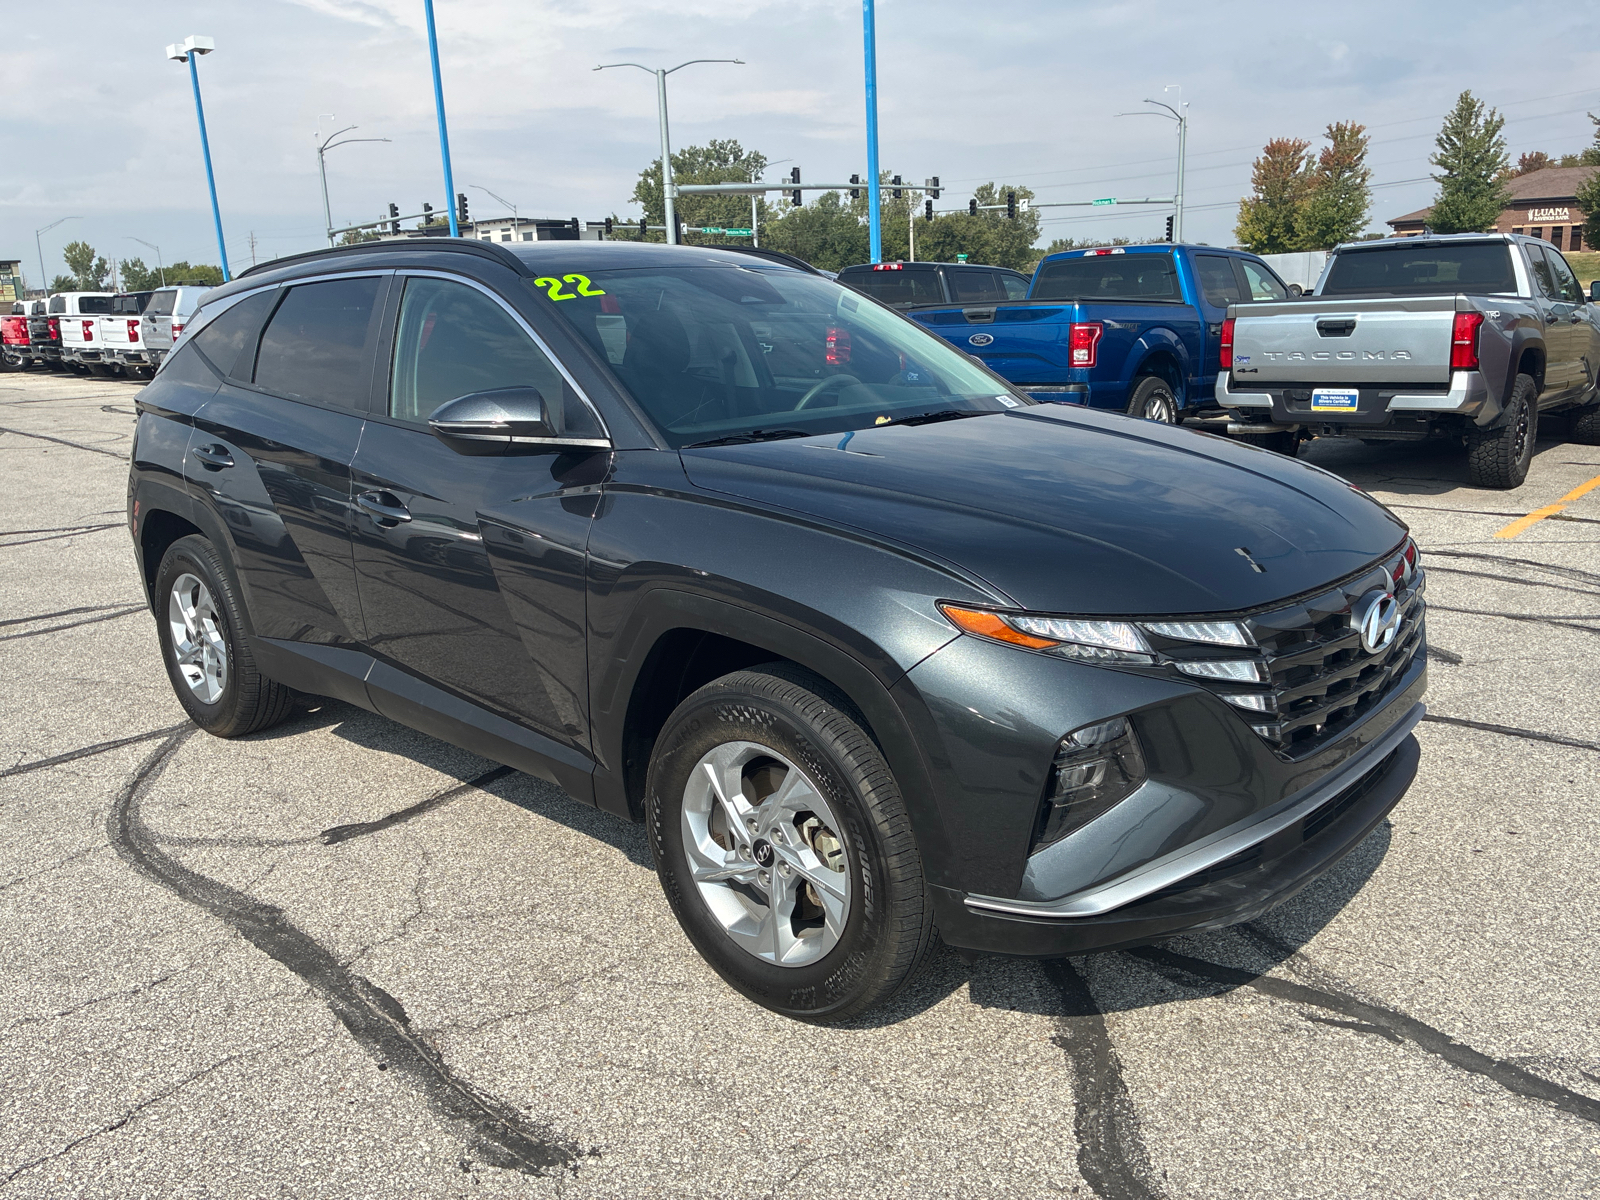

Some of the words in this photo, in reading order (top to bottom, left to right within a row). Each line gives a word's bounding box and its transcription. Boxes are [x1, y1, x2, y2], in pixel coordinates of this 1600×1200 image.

[1534, 207, 1570, 216] LUANA
[534, 273, 606, 301] 22
[1485, 310, 1501, 319] TRD
[1263, 350, 1412, 361] TACOMA
[850, 816, 875, 922] CRUGEN
